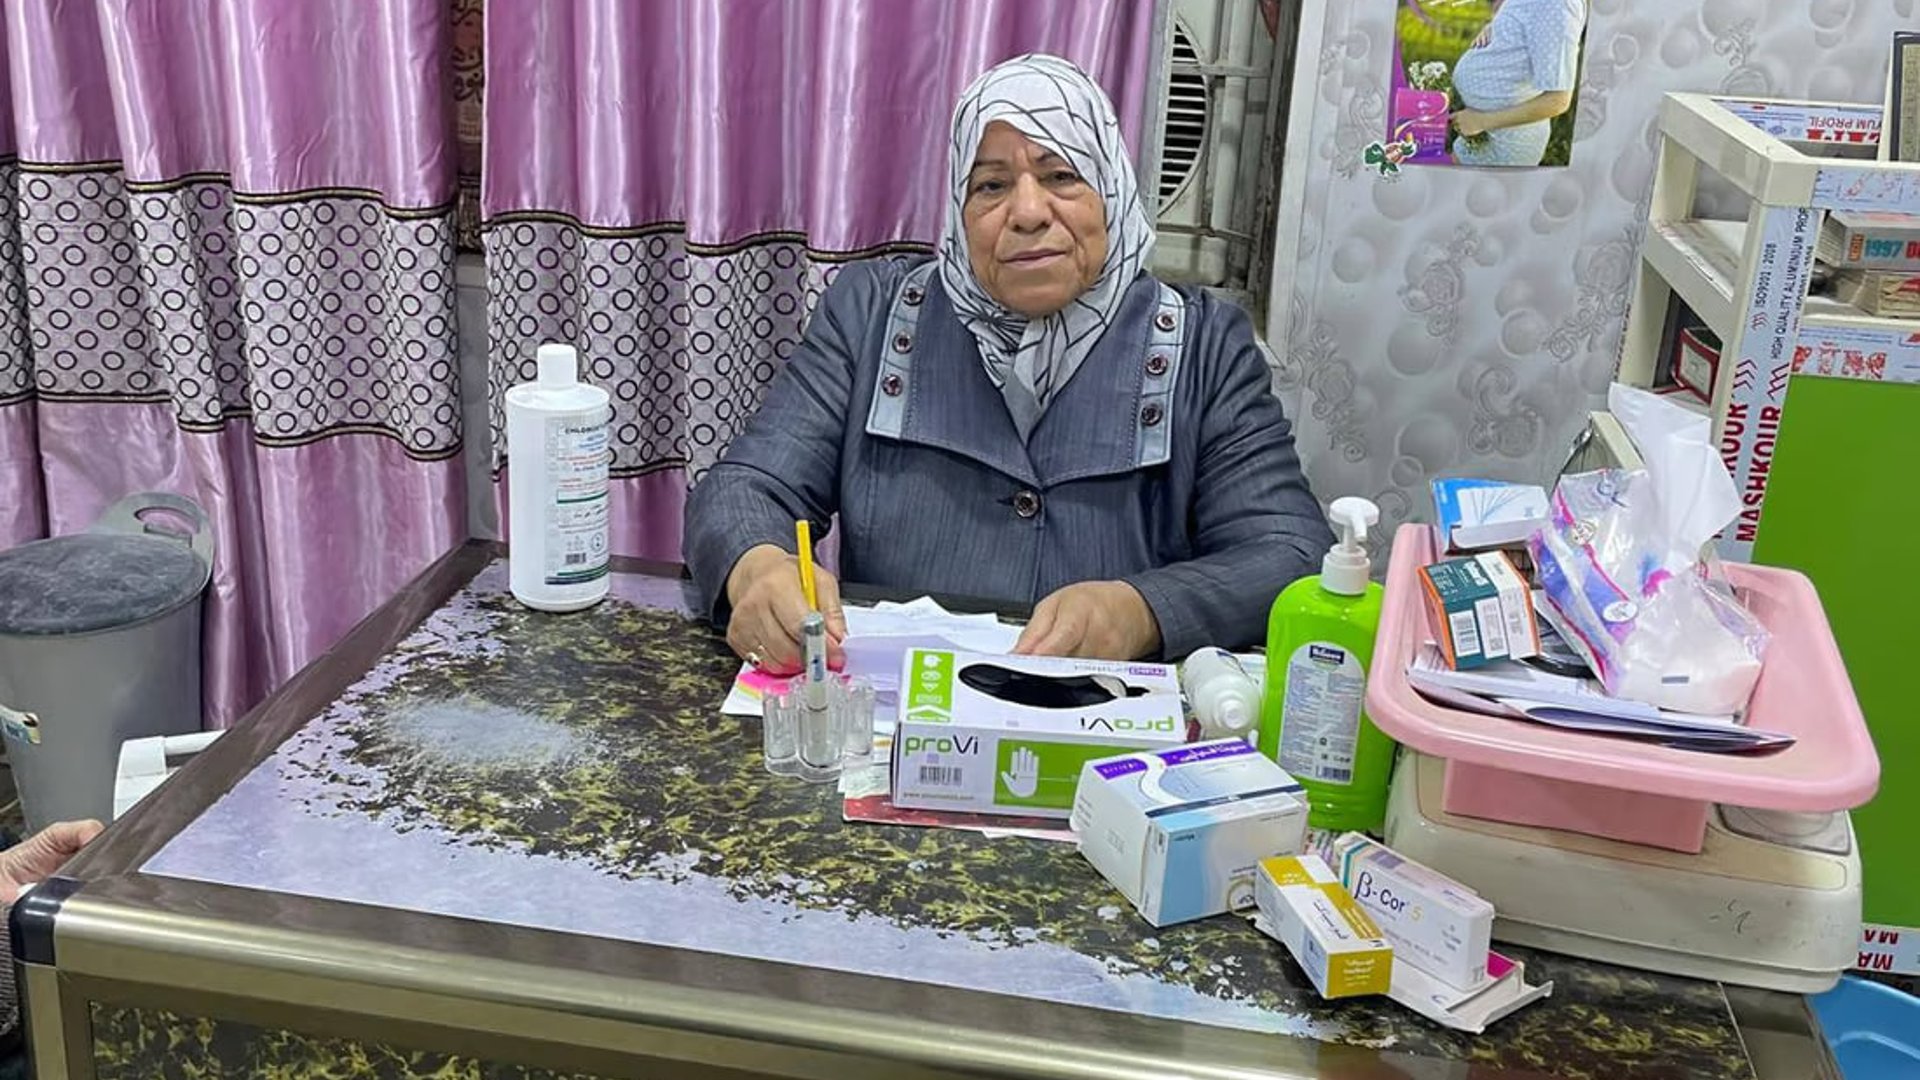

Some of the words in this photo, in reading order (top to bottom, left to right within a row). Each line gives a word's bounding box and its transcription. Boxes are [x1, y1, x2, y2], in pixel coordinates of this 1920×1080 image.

[1865, 239, 1903, 258] 1997
[1775, 294, 1793, 335] QUALITY
[1771, 336, 1785, 360] HIGH
[1735, 405, 1781, 542] MASHKOUR
[1080, 715, 1175, 733] proVi
[905, 734, 978, 757] proVi
